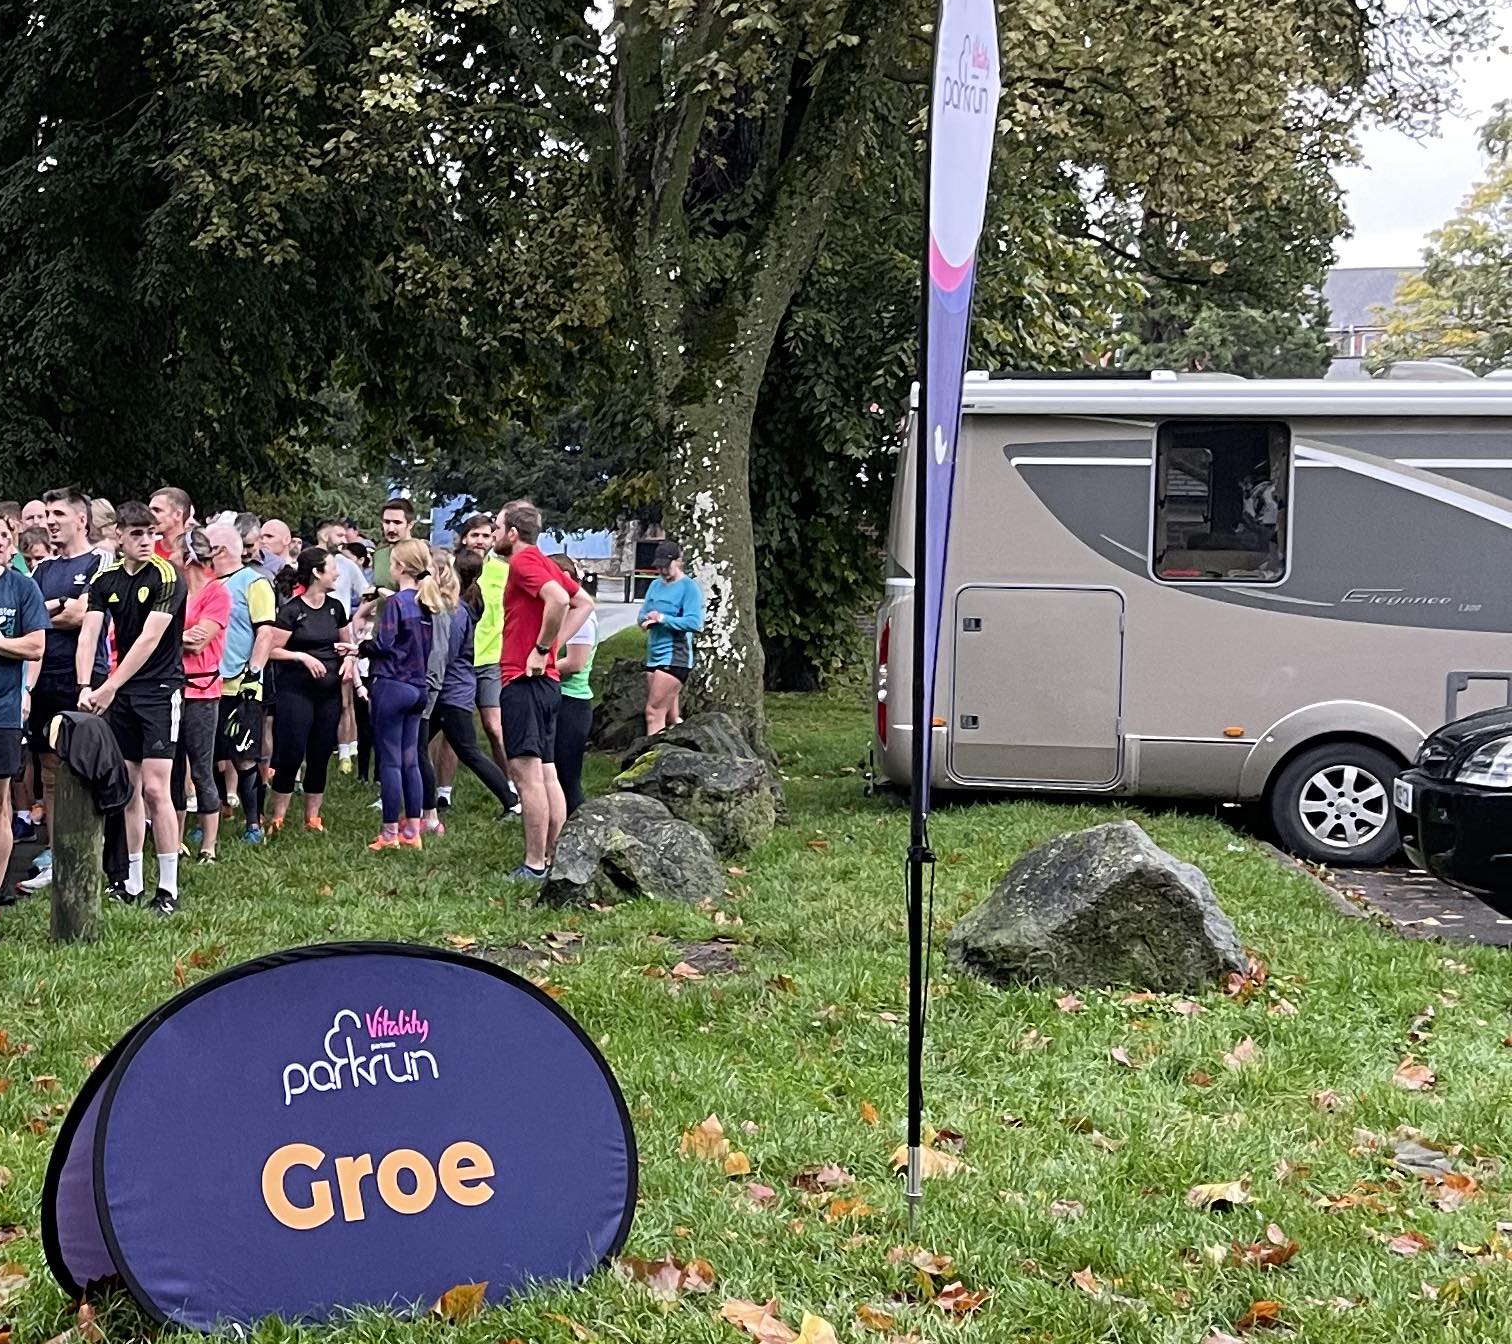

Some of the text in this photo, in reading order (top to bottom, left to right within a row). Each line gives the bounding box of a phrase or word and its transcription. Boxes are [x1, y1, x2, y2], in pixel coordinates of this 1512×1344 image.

[366, 1006, 429, 1043] Vitality
[283, 1036, 439, 1106] parkrun
[262, 1141, 496, 1230] Groe
